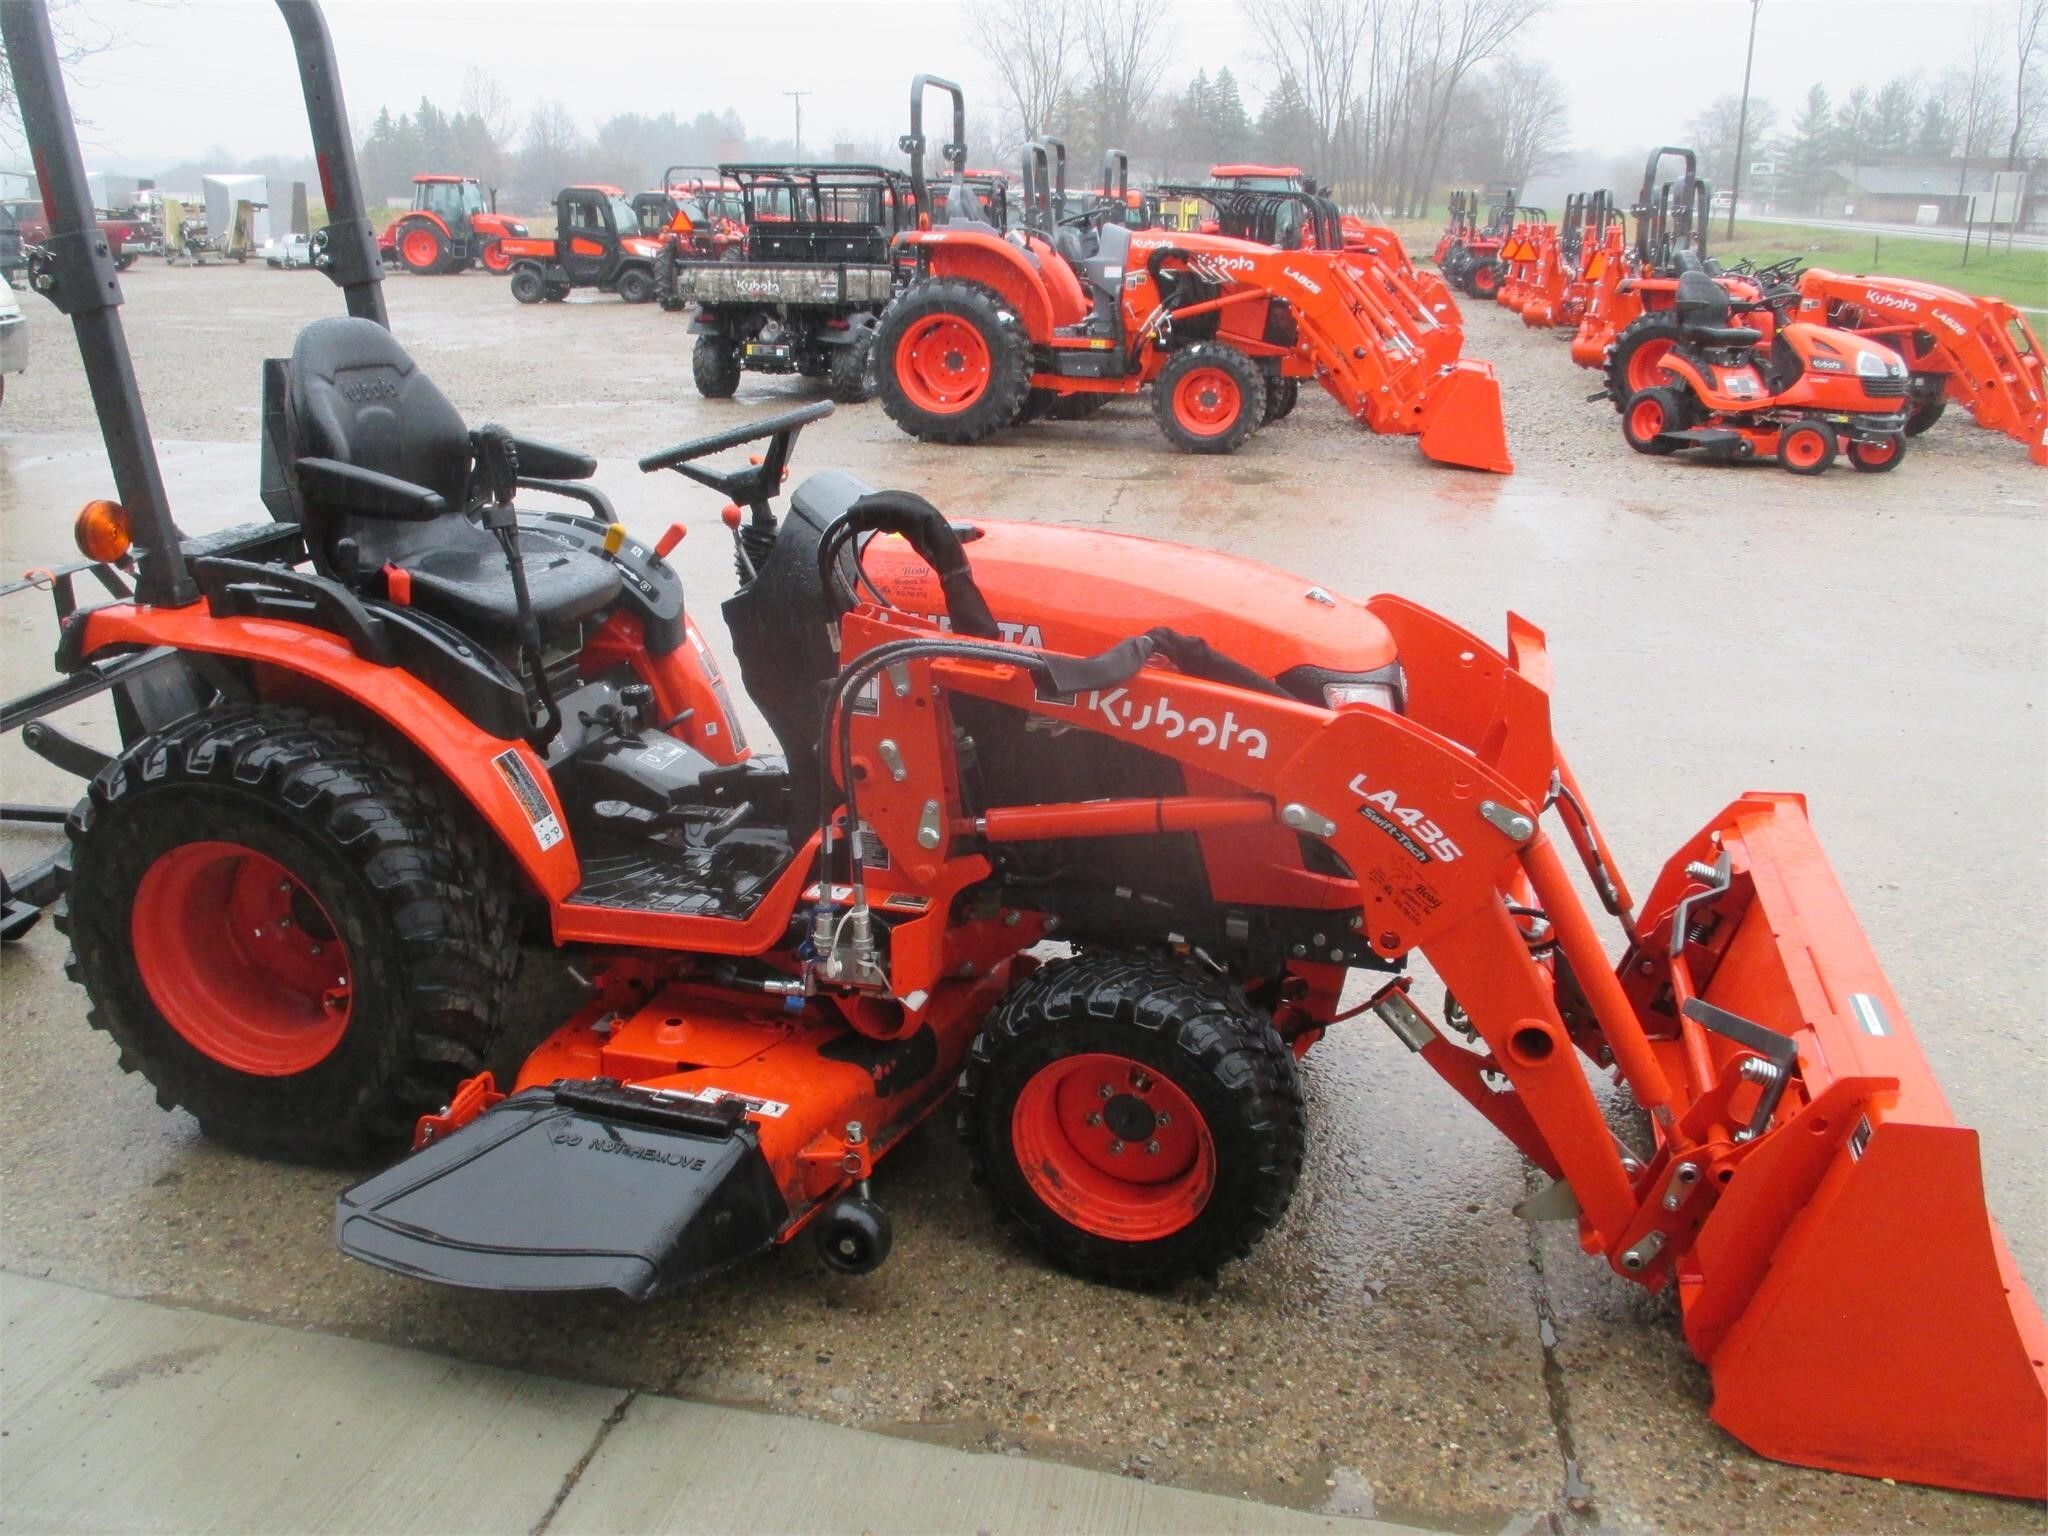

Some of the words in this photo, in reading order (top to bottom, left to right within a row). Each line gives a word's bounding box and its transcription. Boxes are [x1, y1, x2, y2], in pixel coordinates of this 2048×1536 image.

[1132, 239, 1174, 249] Kubota
[736, 280, 780, 293] Kubota
[1866, 290, 1919, 312] Kubota
[1088, 687, 1269, 760] Kubota
[1348, 773, 1464, 864] LA435
[1360, 806, 1428, 863] Swift-Tach
